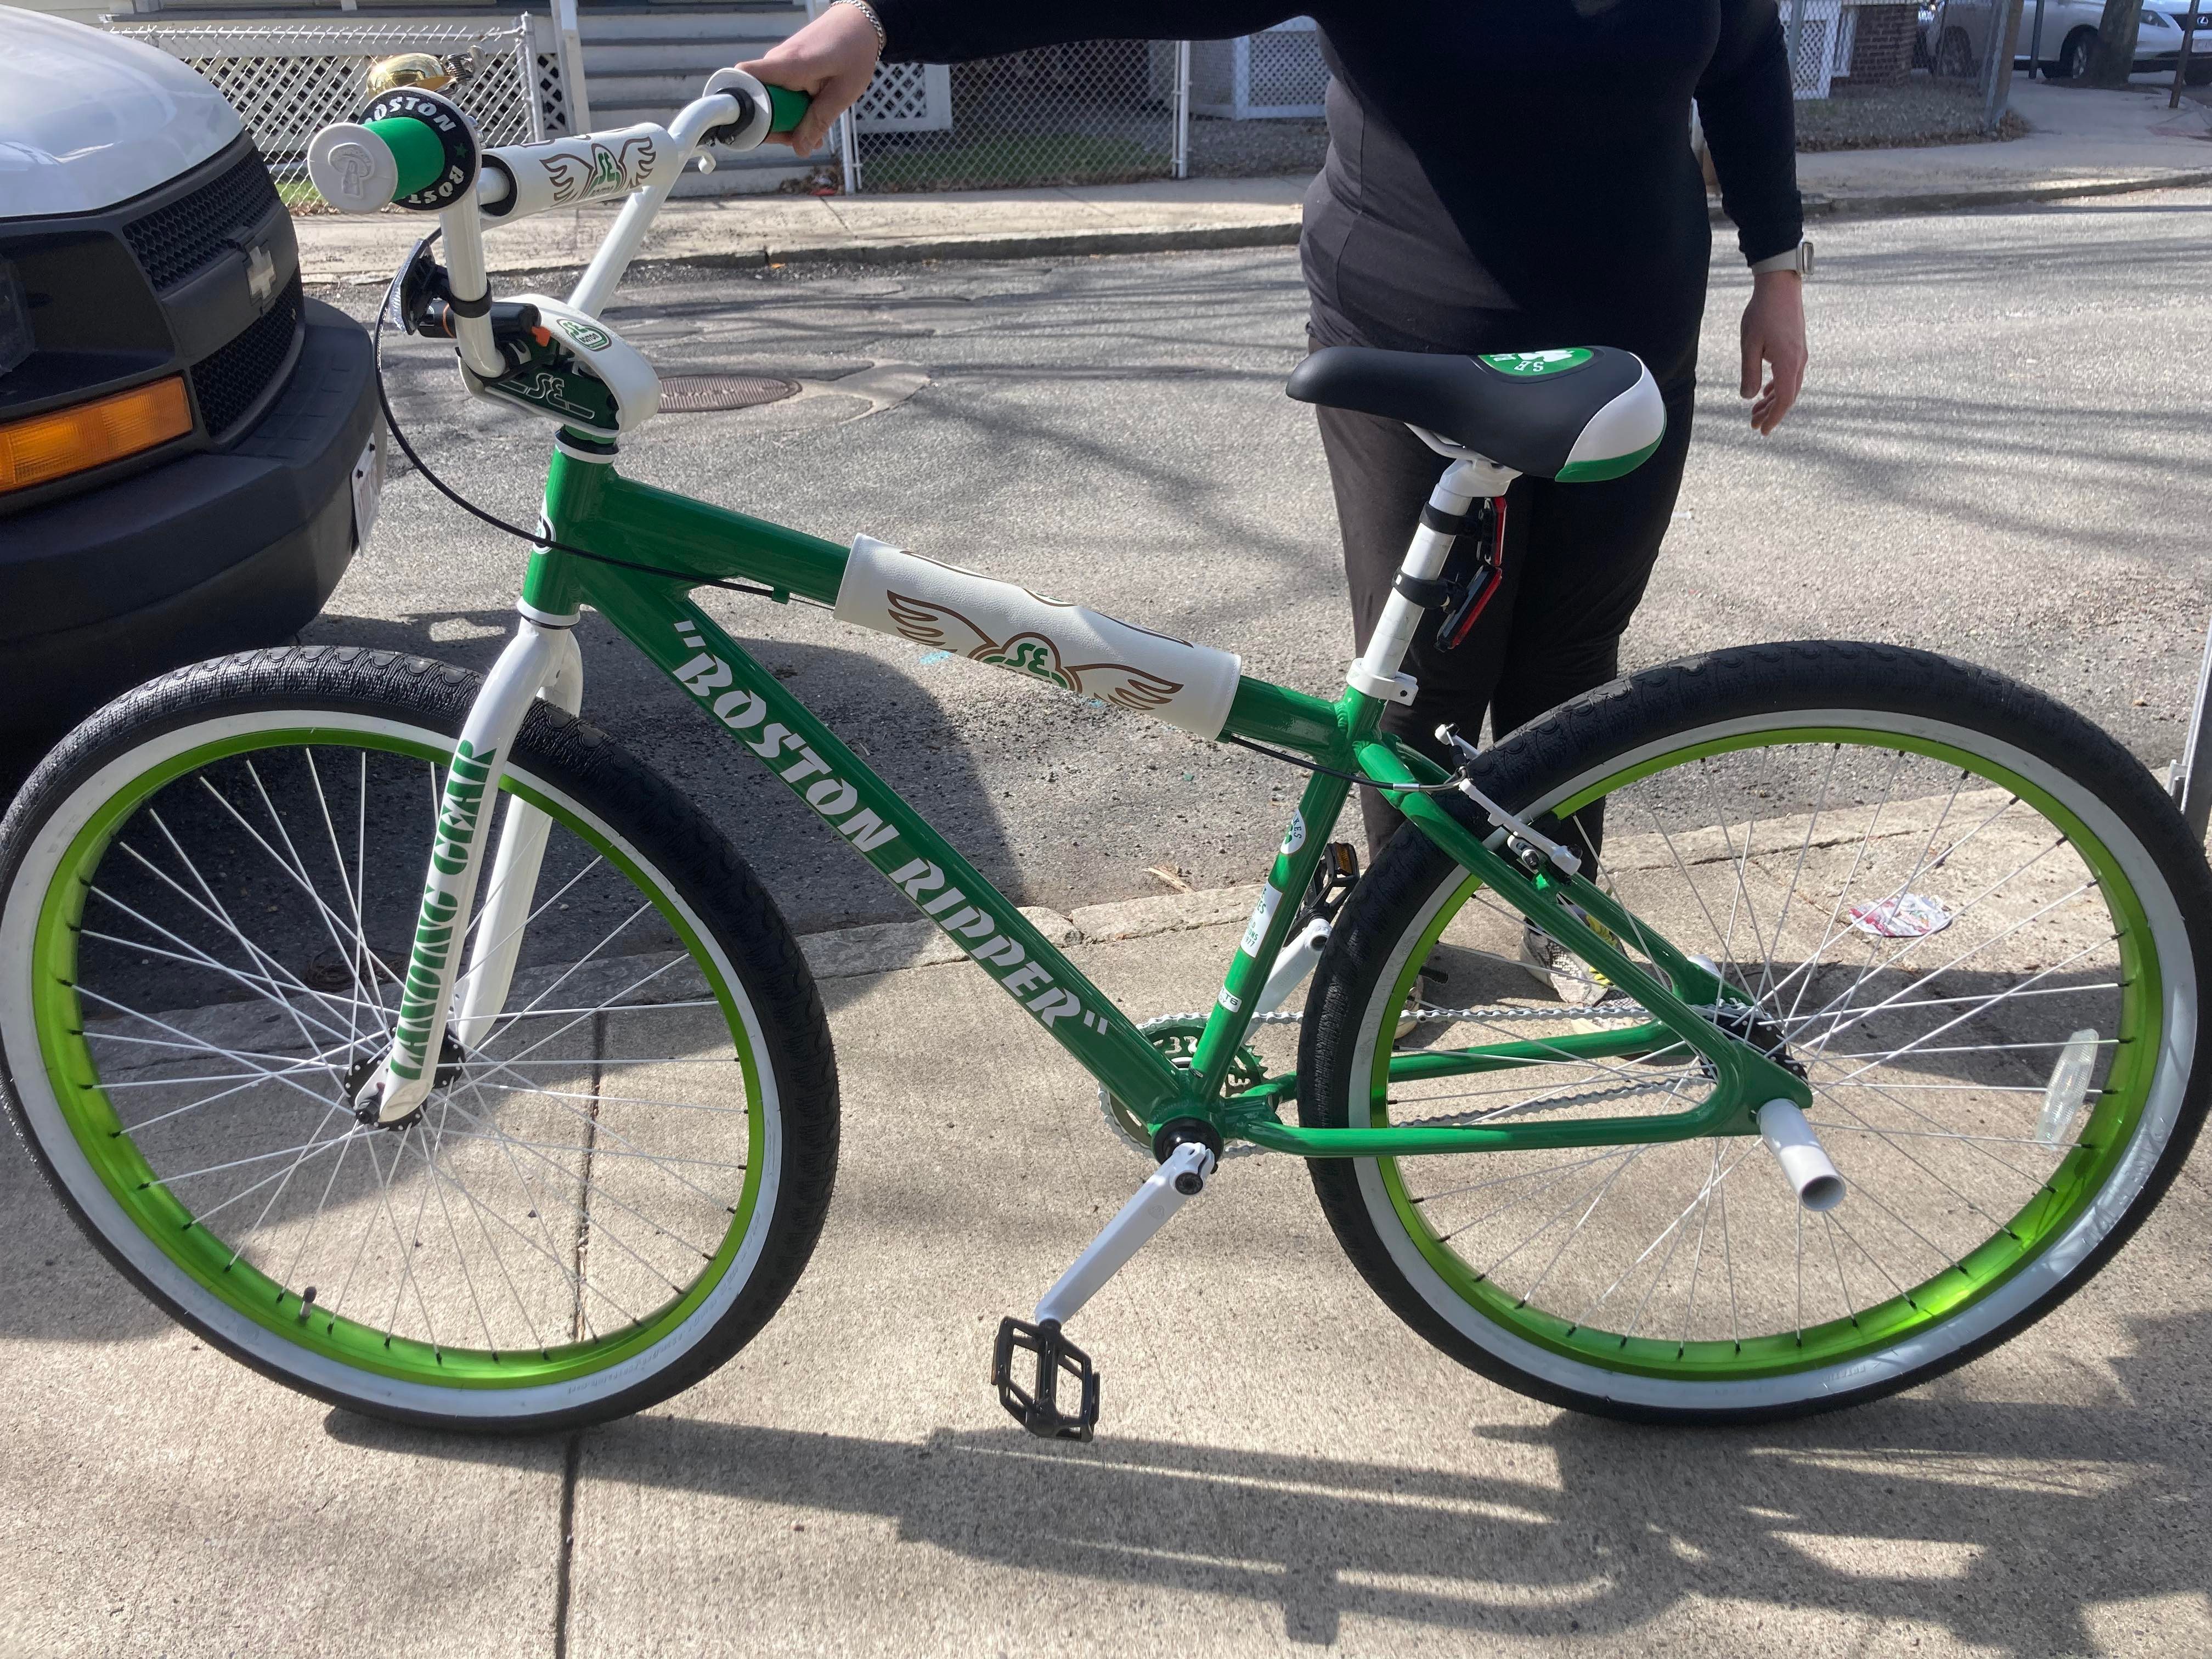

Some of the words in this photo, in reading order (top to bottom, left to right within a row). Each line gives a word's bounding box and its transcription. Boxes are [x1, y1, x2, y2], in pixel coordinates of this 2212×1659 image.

[408, 165, 464, 204] BOST
[1004, 642, 1050, 678] SE
[390, 885, 458, 1080] LANDING
[433, 739, 497, 876] GEAR
